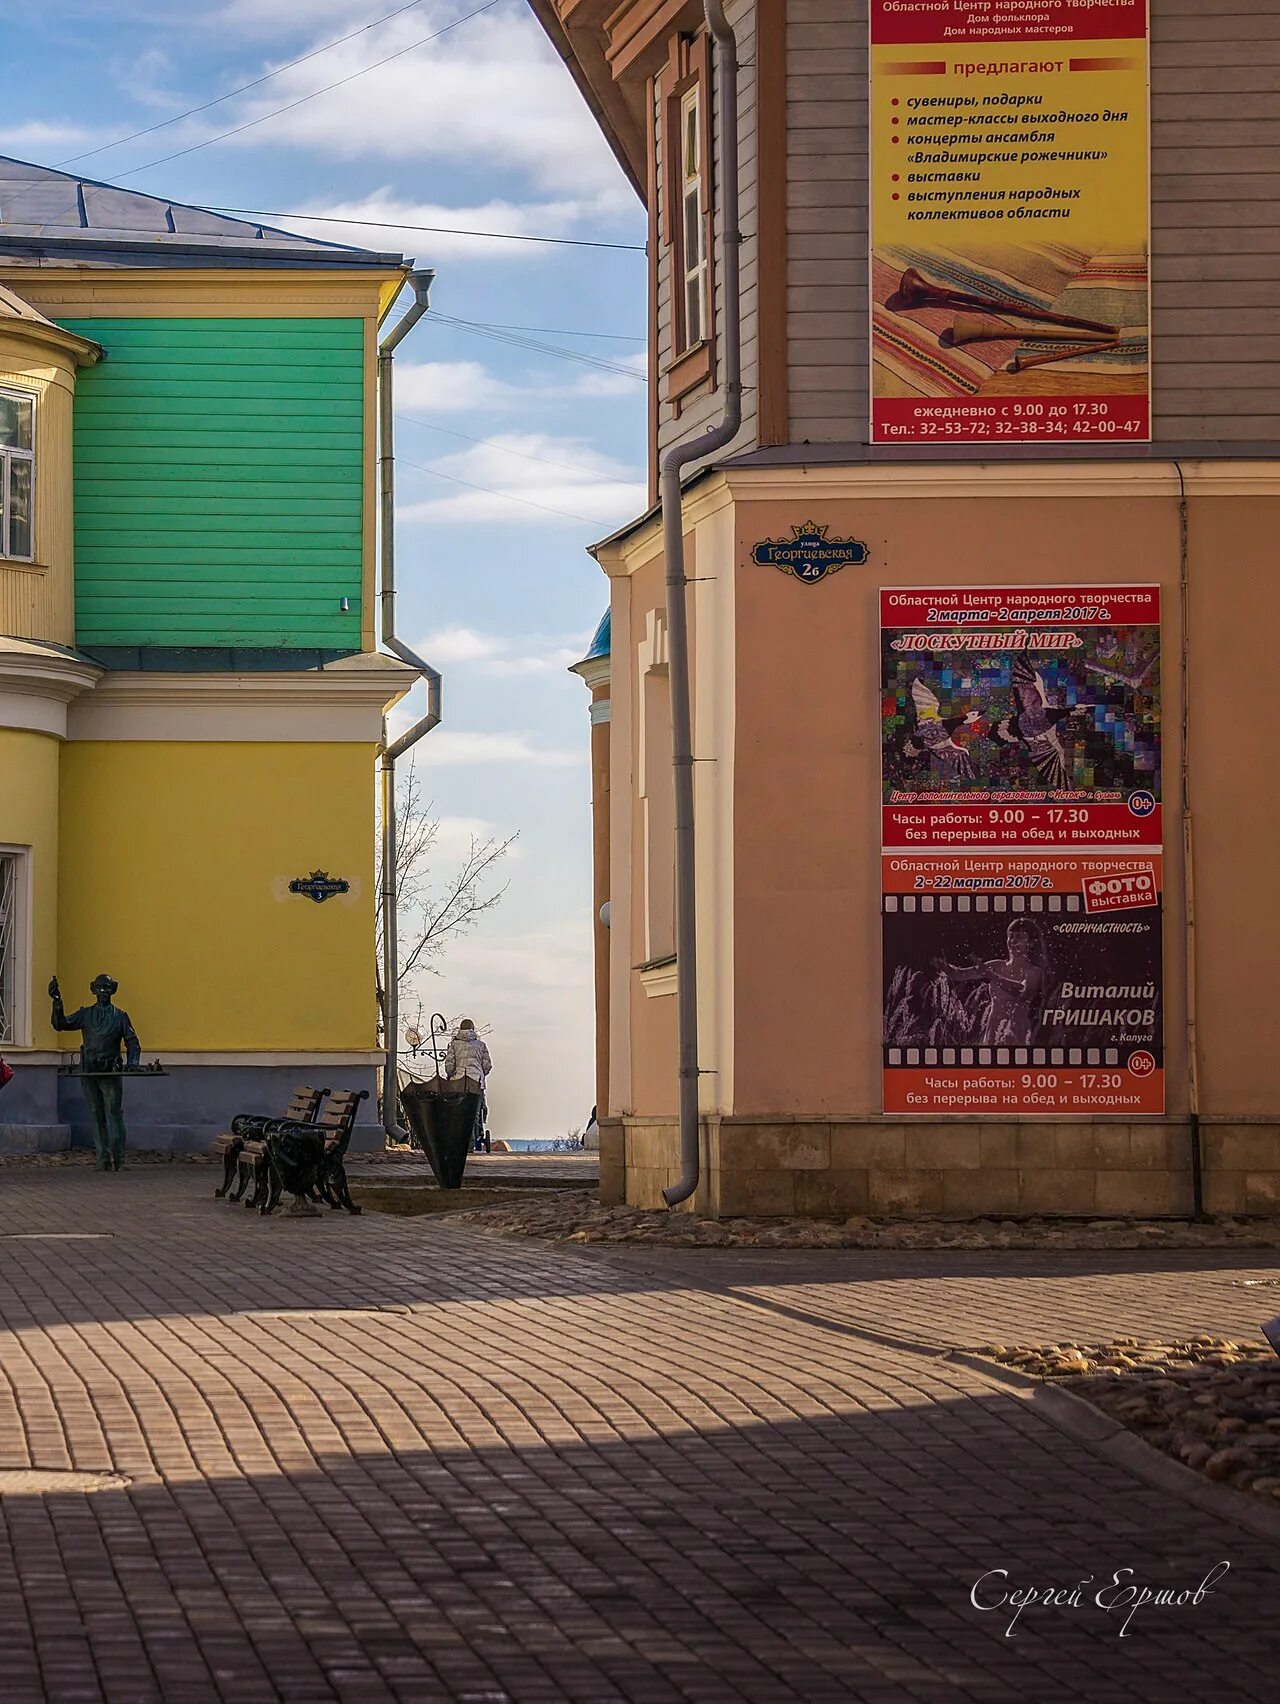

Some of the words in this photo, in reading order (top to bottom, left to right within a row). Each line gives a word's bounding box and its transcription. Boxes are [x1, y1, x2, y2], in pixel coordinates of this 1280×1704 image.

[883, 1, 949, 12] Областной
[954, 0, 991, 12] Центр
[995, 0, 1062, 11] народного
[1067, 0, 1135, 9] творчества
[967, 14, 989, 23] Дом
[993, 13, 1050, 23] фольклора
[943, 26, 966, 36] Дом
[969, 26, 1022, 36] народных
[1025, 25, 1074, 35] мастеров
[953, 60, 1063, 77] предлагают
[907, 94, 979, 108] сувениры,
[982, 93, 1042, 107] подарки
[907, 114, 1018, 128] мастер-классы
[1021, 112, 1099, 124] выходного
[1102, 110, 1128, 124] дня
[907, 133, 982, 148] концерты
[986, 131, 1055, 143] ансамбля
[907, 151, 1018, 165] «Владимирские
[1021, 150, 1108, 165] рожечники»
[907, 171, 980, 183] выставки
[907, 189, 1005, 204] выступления
[1008, 187, 1081, 200] народных
[907, 208, 1004, 221] коллективов
[1007, 206, 1070, 219] области
[914, 405, 996, 418] ежедневно
[1002, 407, 1009, 416] с
[1013, 404, 1043, 416] 9.00
[1049, 406, 1067, 418] до
[1073, 403, 1108, 415] 17.30
[881, 423, 915, 435] Тел.:
[768, 546, 853, 561] Георгиевская
[889, 594, 958, 605] Областной
[963, 594, 1002, 607] Центр
[1007, 595, 1076, 607] народного
[1080, 594, 1152, 606] творчества
[927, 608, 938, 621] 2
[939, 609, 990, 624] марта
[998, 608, 1009, 621] 2
[1010, 608, 1062, 623] апреля
[1062, 606, 1099, 620] 2017
[1099, 608, 1112, 620] г.
[890, 629, 1028, 650] «ЛОСКУТНЫЙ
[1028, 632, 1083, 649] МИР»
[890, 790, 918, 803] Центр
[991, 789, 1046, 802] образования
[1132, 796, 1152, 810] 0+
[892, 814, 926, 824] Часы
[930, 813, 983, 826] работы:
[989, 810, 1024, 823] 9.00
[1046, 809, 1089, 823] 17.30
[905, 828, 927, 839] без
[932, 830, 997, 842] перерыва
[1001, 830, 1017, 839] на
[1022, 828, 1054, 841] обед
[1058, 829, 1067, 839] и
[1072, 828, 1140, 840] выходных
[890, 860, 960, 871] Областной
[964, 860, 1003, 873] Центр
[1008, 861, 1077, 873] народного
[1082, 860, 1153, 872] творчества
[914, 876, 924, 888] 2
[933, 875, 951, 888] 22
[953, 876, 1004, 891] марта
[1005, 875, 1041, 888] 2017
[1042, 877, 1053, 888] г.
[1089, 876, 1151, 896] ФОТО
[1091, 891, 1152, 907] выставка
[1053, 922, 1150, 934] «СОПРИЧАСТНОСТЬ»
[1061, 981, 1155, 999] Виталий
[1042, 1008, 1155, 1027] ГРИШАКОВ
[1110, 1034, 1118, 1042] г.
[1120, 1032, 1153, 1045] Калуга
[1132, 1056, 1151, 1070] 0+
[925, 1078, 958, 1088] Часы
[963, 1077, 1015, 1091] работы:
[1021, 1075, 1057, 1088] 9.00
[1079, 1075, 1121, 1088] 17.30
[906, 1092, 928, 1104] без
[933, 1094, 997, 1106] перерыва
[1002, 1094, 1018, 1104] на
[1022, 1092, 1055, 1106] обед
[1059, 1094, 1068, 1104] и
[1072, 1093, 1141, 1106] выходных
